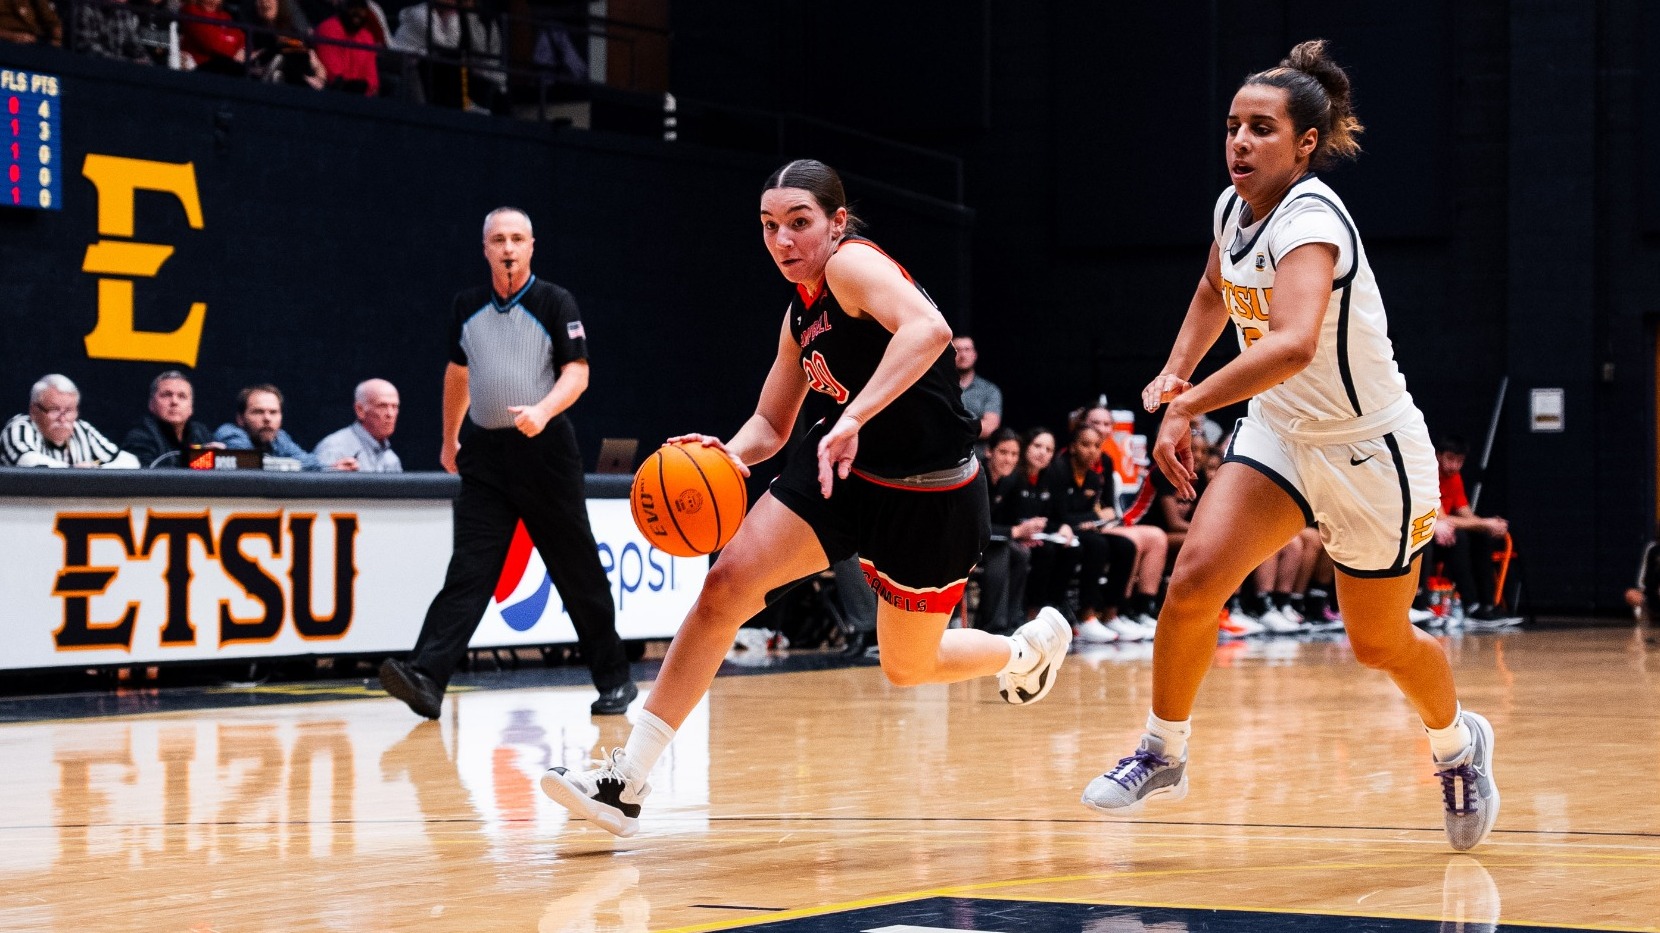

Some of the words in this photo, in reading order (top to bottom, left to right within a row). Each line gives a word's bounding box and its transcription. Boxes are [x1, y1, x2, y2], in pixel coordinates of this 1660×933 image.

[1, 70, 27, 92] FLS
[31, 74, 58, 96] PTS
[38, 100, 50, 119] 4
[10, 118, 19, 136] 1
[39, 121, 51, 141] 3
[10, 142, 19, 160] 1
[11, 186, 20, 205] 1
[81, 153, 208, 368] E
[1222, 278, 1273, 321] TSU
[641, 493, 669, 537] EVO
[51, 507, 360, 653] ETSU
[562, 542, 675, 612] epsi
